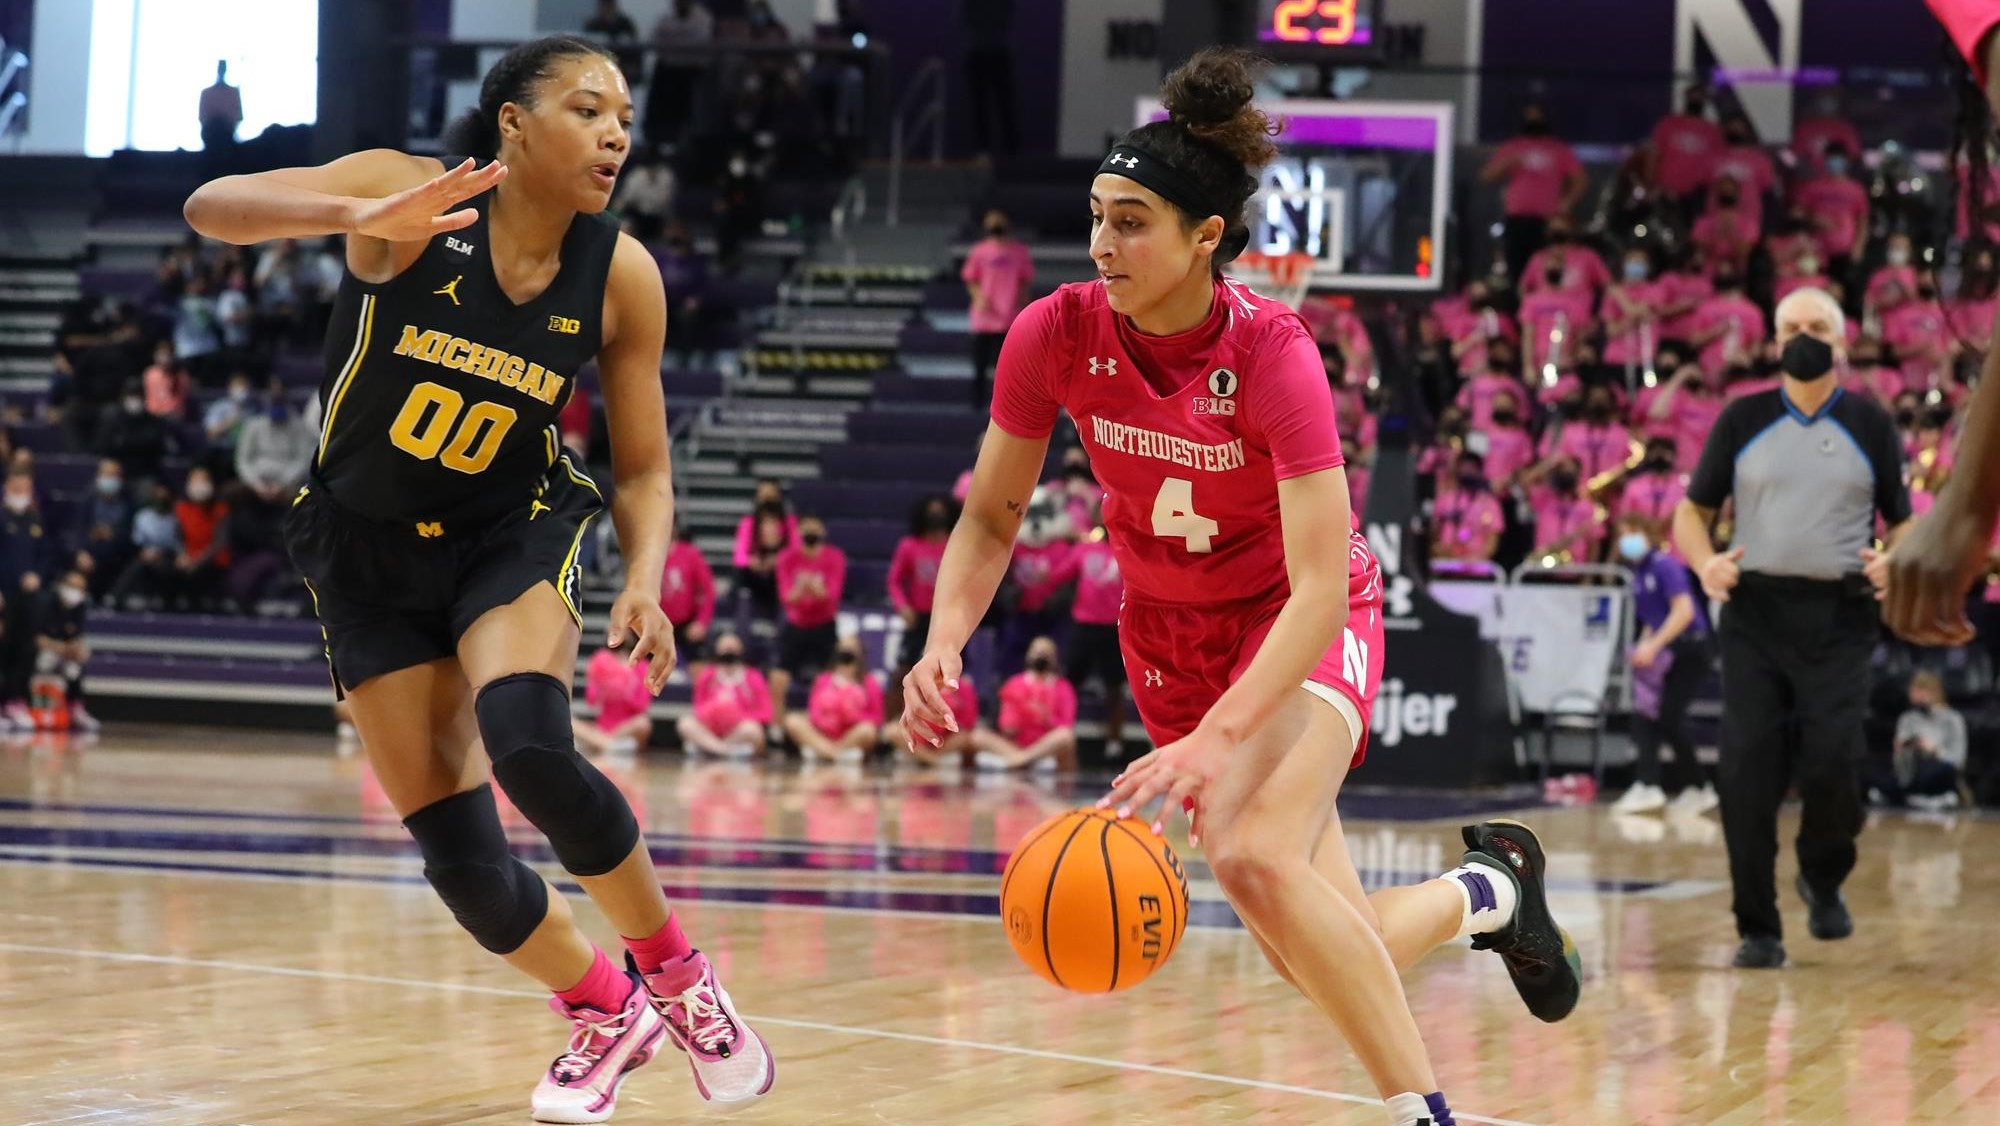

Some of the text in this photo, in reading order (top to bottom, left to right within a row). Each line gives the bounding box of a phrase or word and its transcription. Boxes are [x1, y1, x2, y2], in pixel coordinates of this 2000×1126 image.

[1273, 0, 1358, 44] 23
[445, 236, 474, 255] BLM
[393, 324, 565, 405] MICHIGAN
[389, 381, 517, 475] 00
[1092, 416, 1245, 473] NORTHWESTERN
[415, 521, 445, 538] M
[1151, 477, 1219, 554] 4
[1371, 679, 1456, 747] ijer
